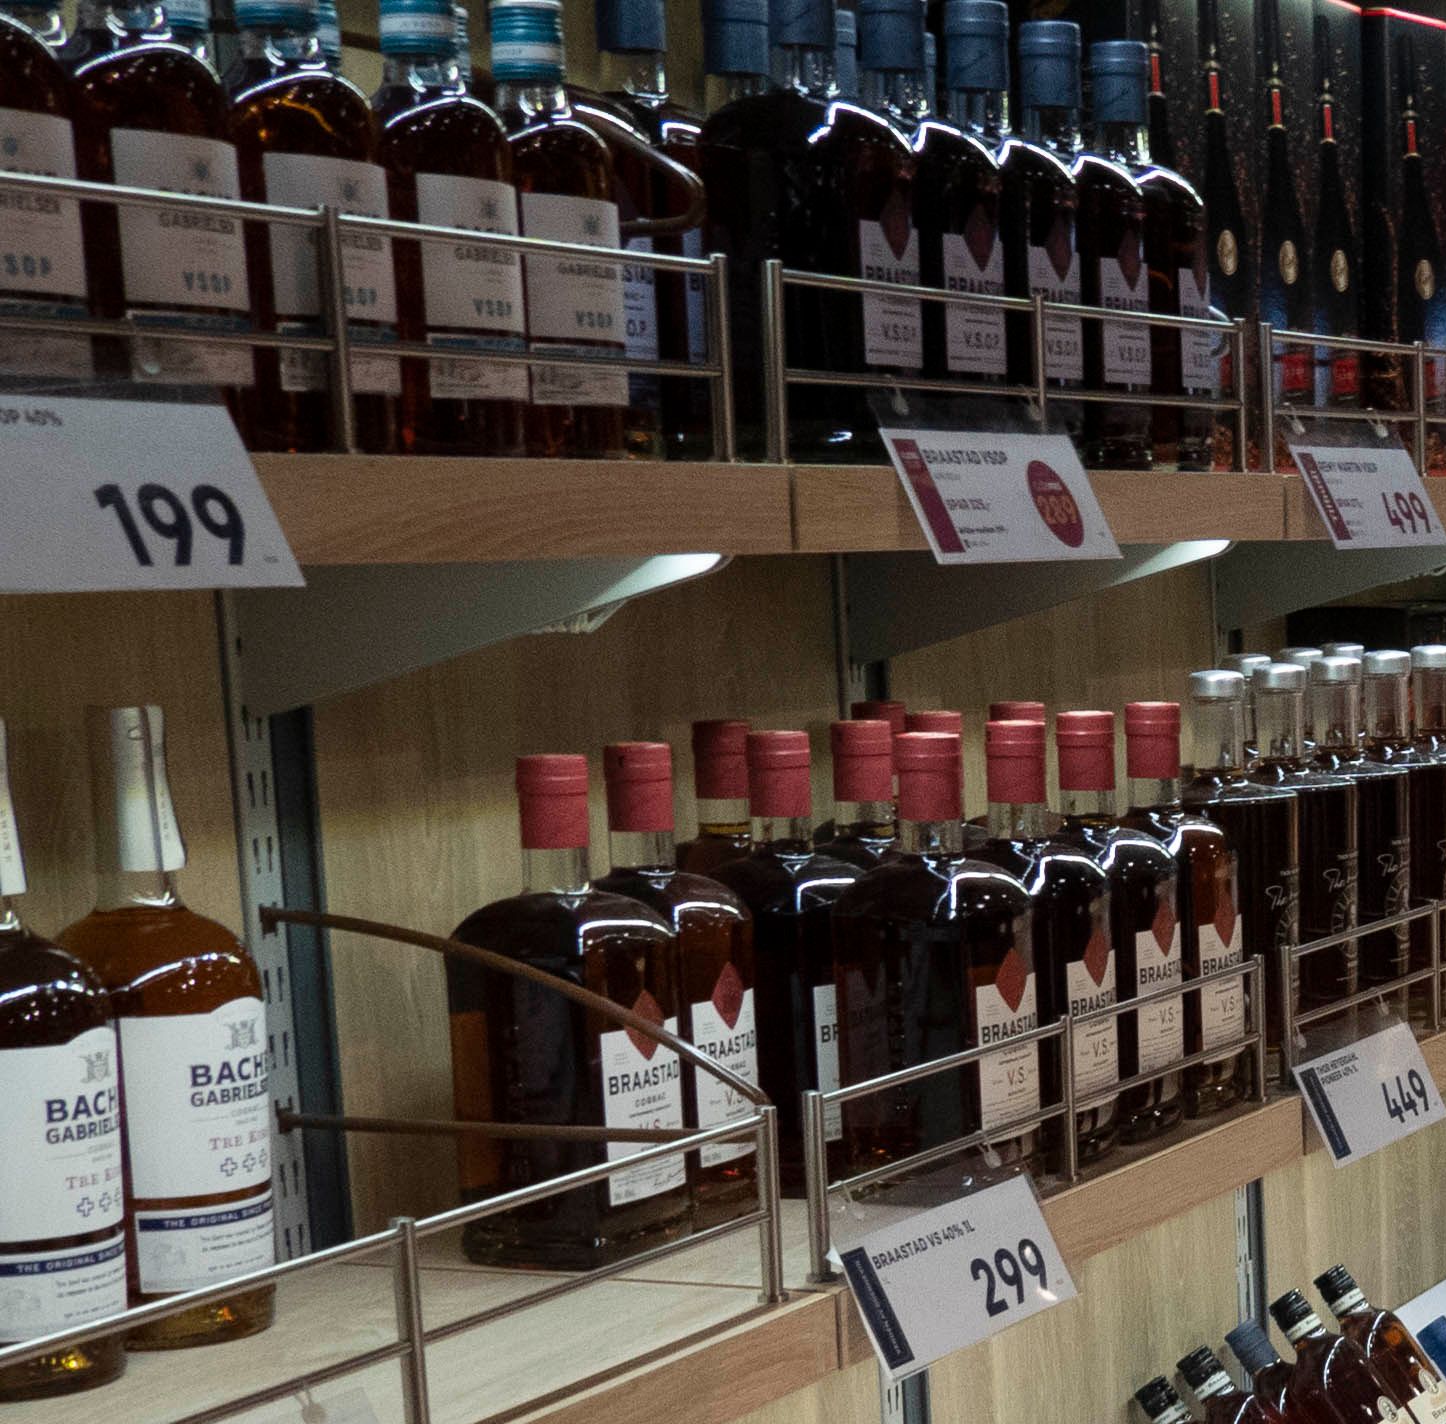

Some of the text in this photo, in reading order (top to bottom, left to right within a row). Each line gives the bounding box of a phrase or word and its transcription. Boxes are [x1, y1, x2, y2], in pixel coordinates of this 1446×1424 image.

[93, 482, 245, 567] 199
[1381, 491, 1432, 534] 499
[608, 1058, 681, 1096] BRAASTAD
[1381, 1068, 1430, 1124] 449
[45, 1085, 118, 1124] BACH
[163, 1219, 186, 1229] THE
[190, 1212, 239, 1227] ORIGINAL
[871, 1236, 929, 1271] BRAASTAD
[927, 1230, 943, 1249] VS
[942, 1222, 964, 1243] 40%
[969, 1237, 1049, 1318] 299
